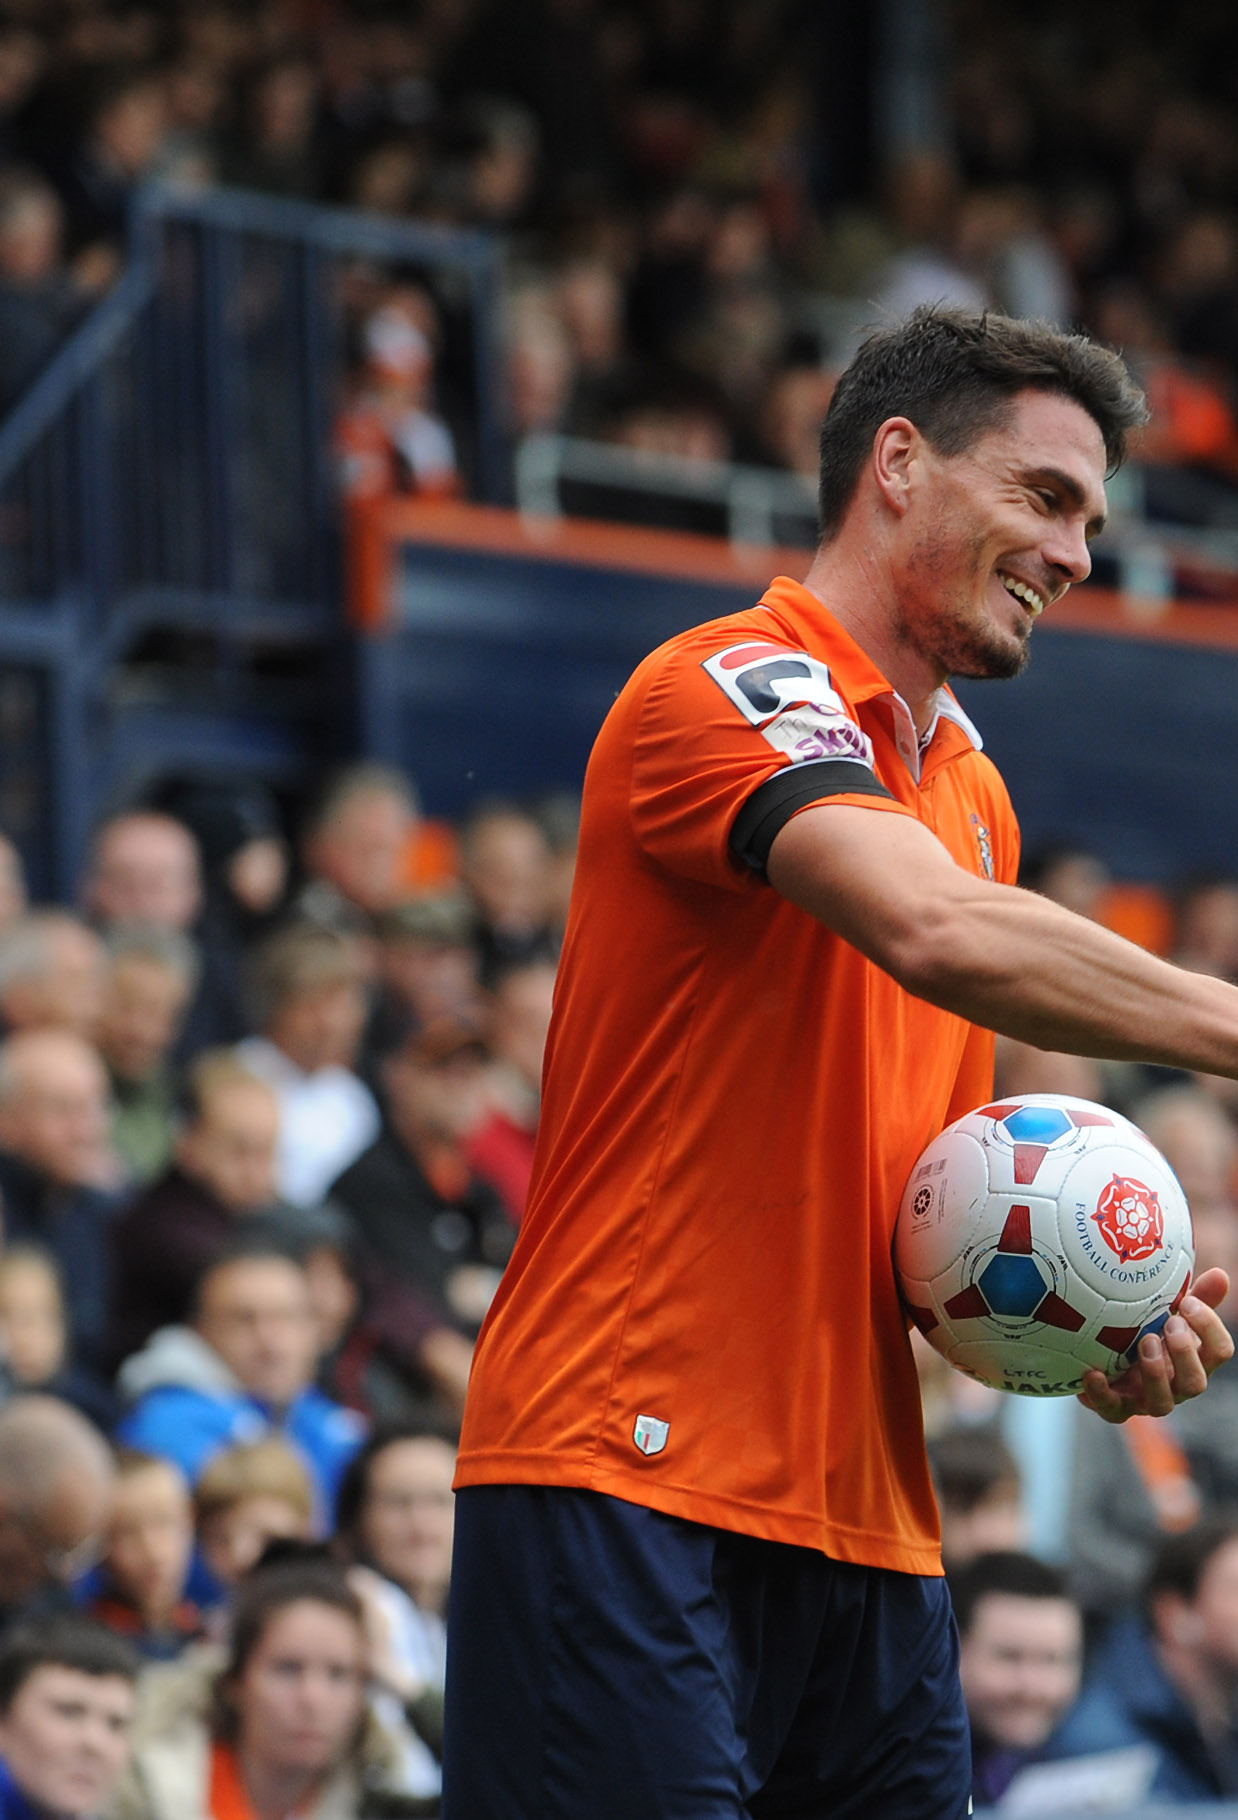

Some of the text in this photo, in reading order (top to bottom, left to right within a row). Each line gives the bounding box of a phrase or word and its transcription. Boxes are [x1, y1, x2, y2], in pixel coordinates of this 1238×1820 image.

[1074, 1202, 1175, 1284] FOOTBALL CONFERENCE
[1003, 1369, 1047, 1379] LTFC
